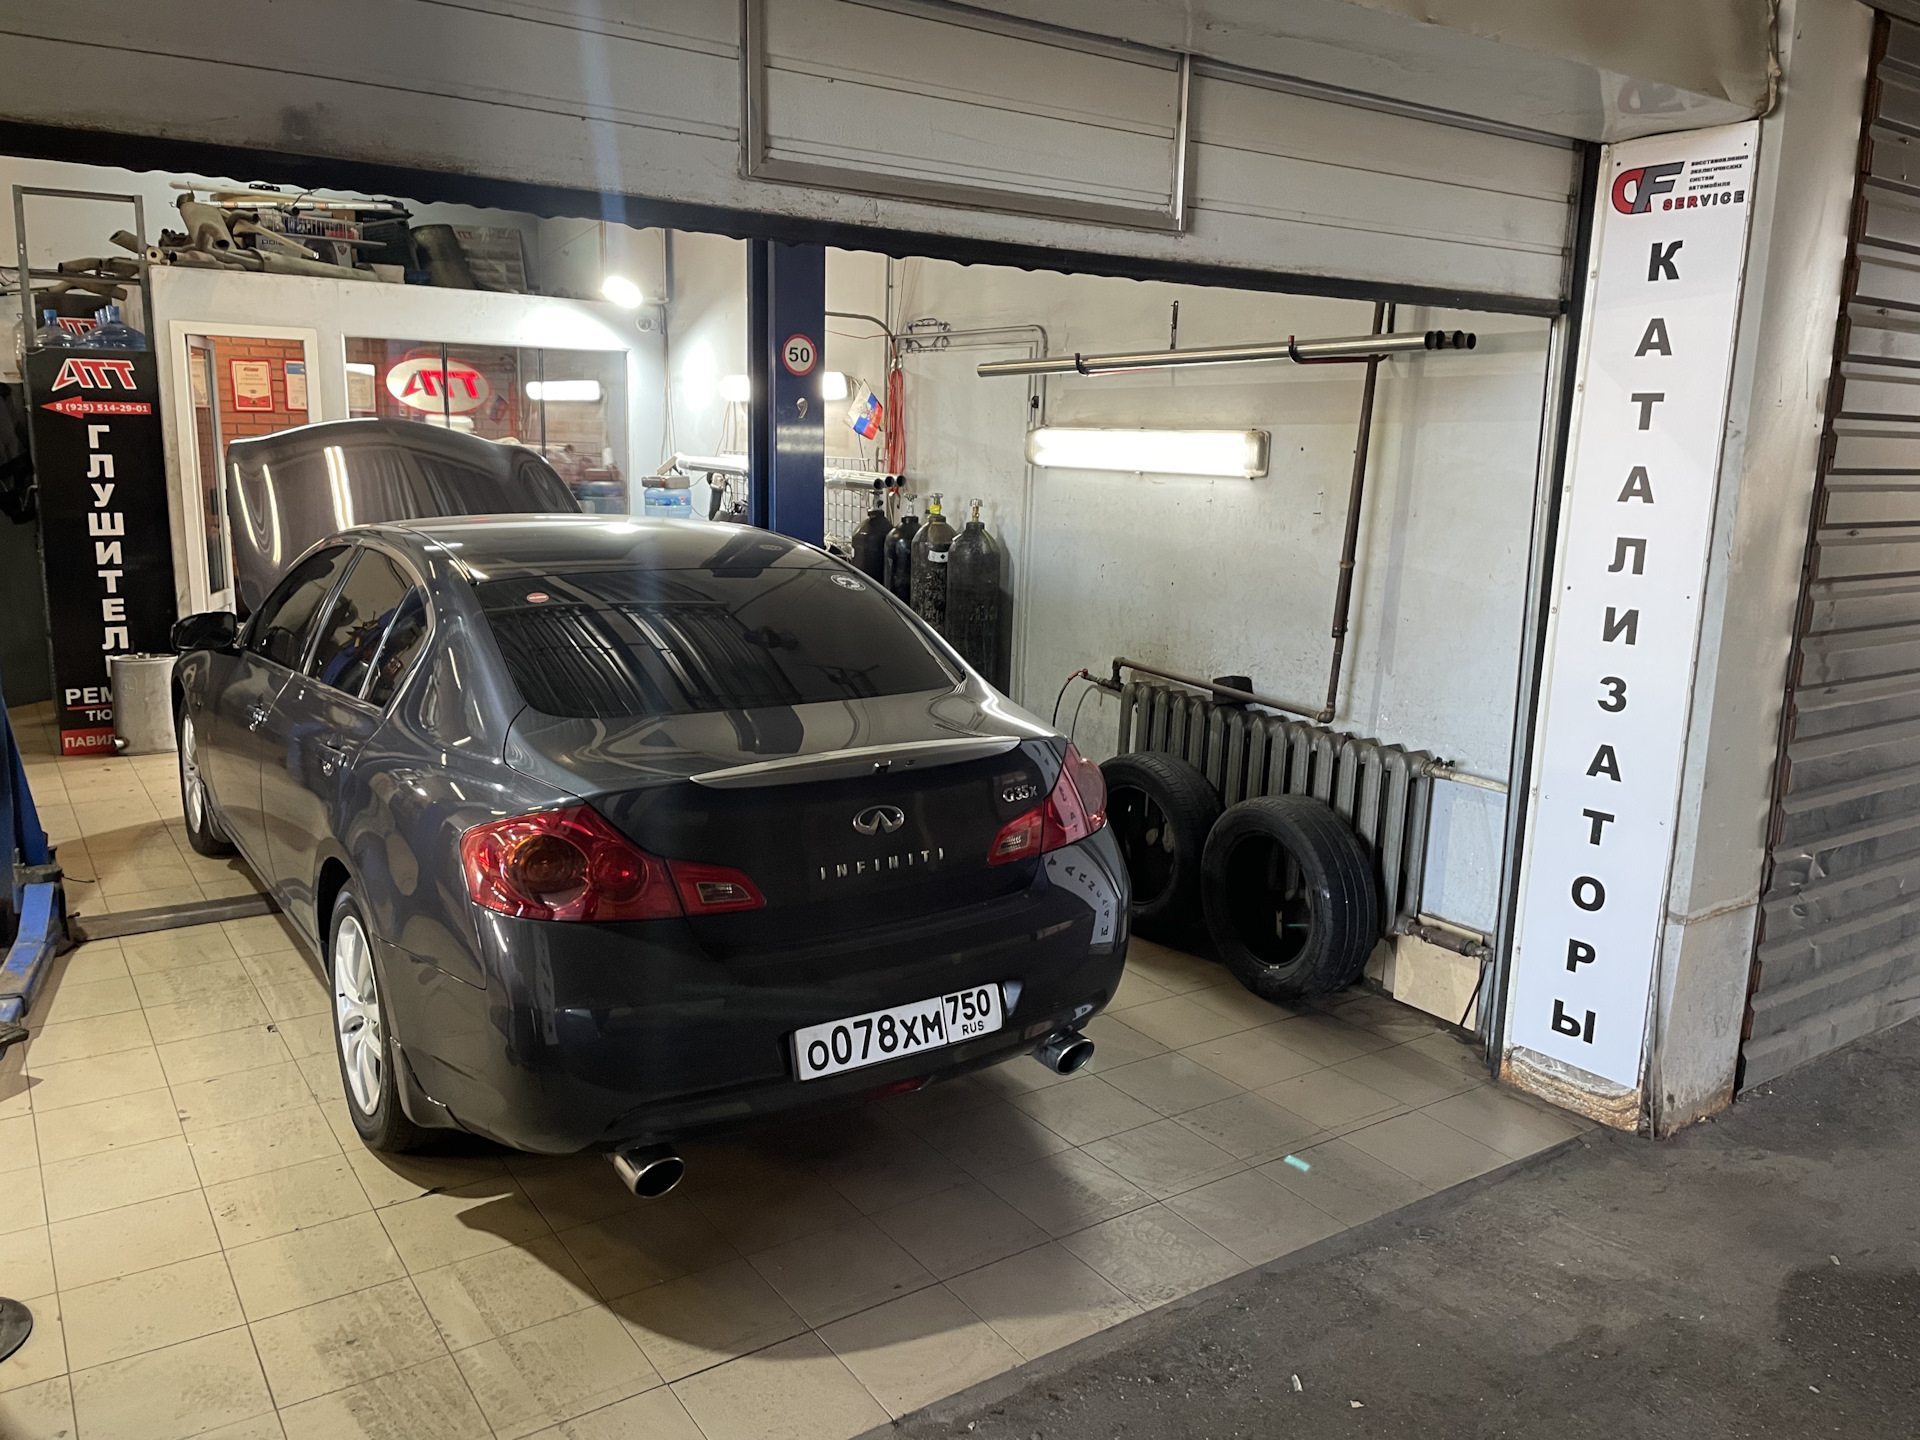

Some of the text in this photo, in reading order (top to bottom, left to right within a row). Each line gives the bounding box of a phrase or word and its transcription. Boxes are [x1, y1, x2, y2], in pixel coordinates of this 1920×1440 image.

[1663, 190, 1745, 211] SERVICE
[789, 347, 810, 363] 50
[51, 358, 137, 391] ATT
[55, 403, 148, 413] 8 (925) 514-29-01
[87, 424, 129, 678] ГЛУШИТЕЛ
[1551, 240, 1683, 1044] КАТАЛИЗАТОРЫ
[820, 847, 944, 880] INFINITI
[808, 989, 991, 1070] О078ХМ 750
[962, 1020, 985, 1036] RUS
